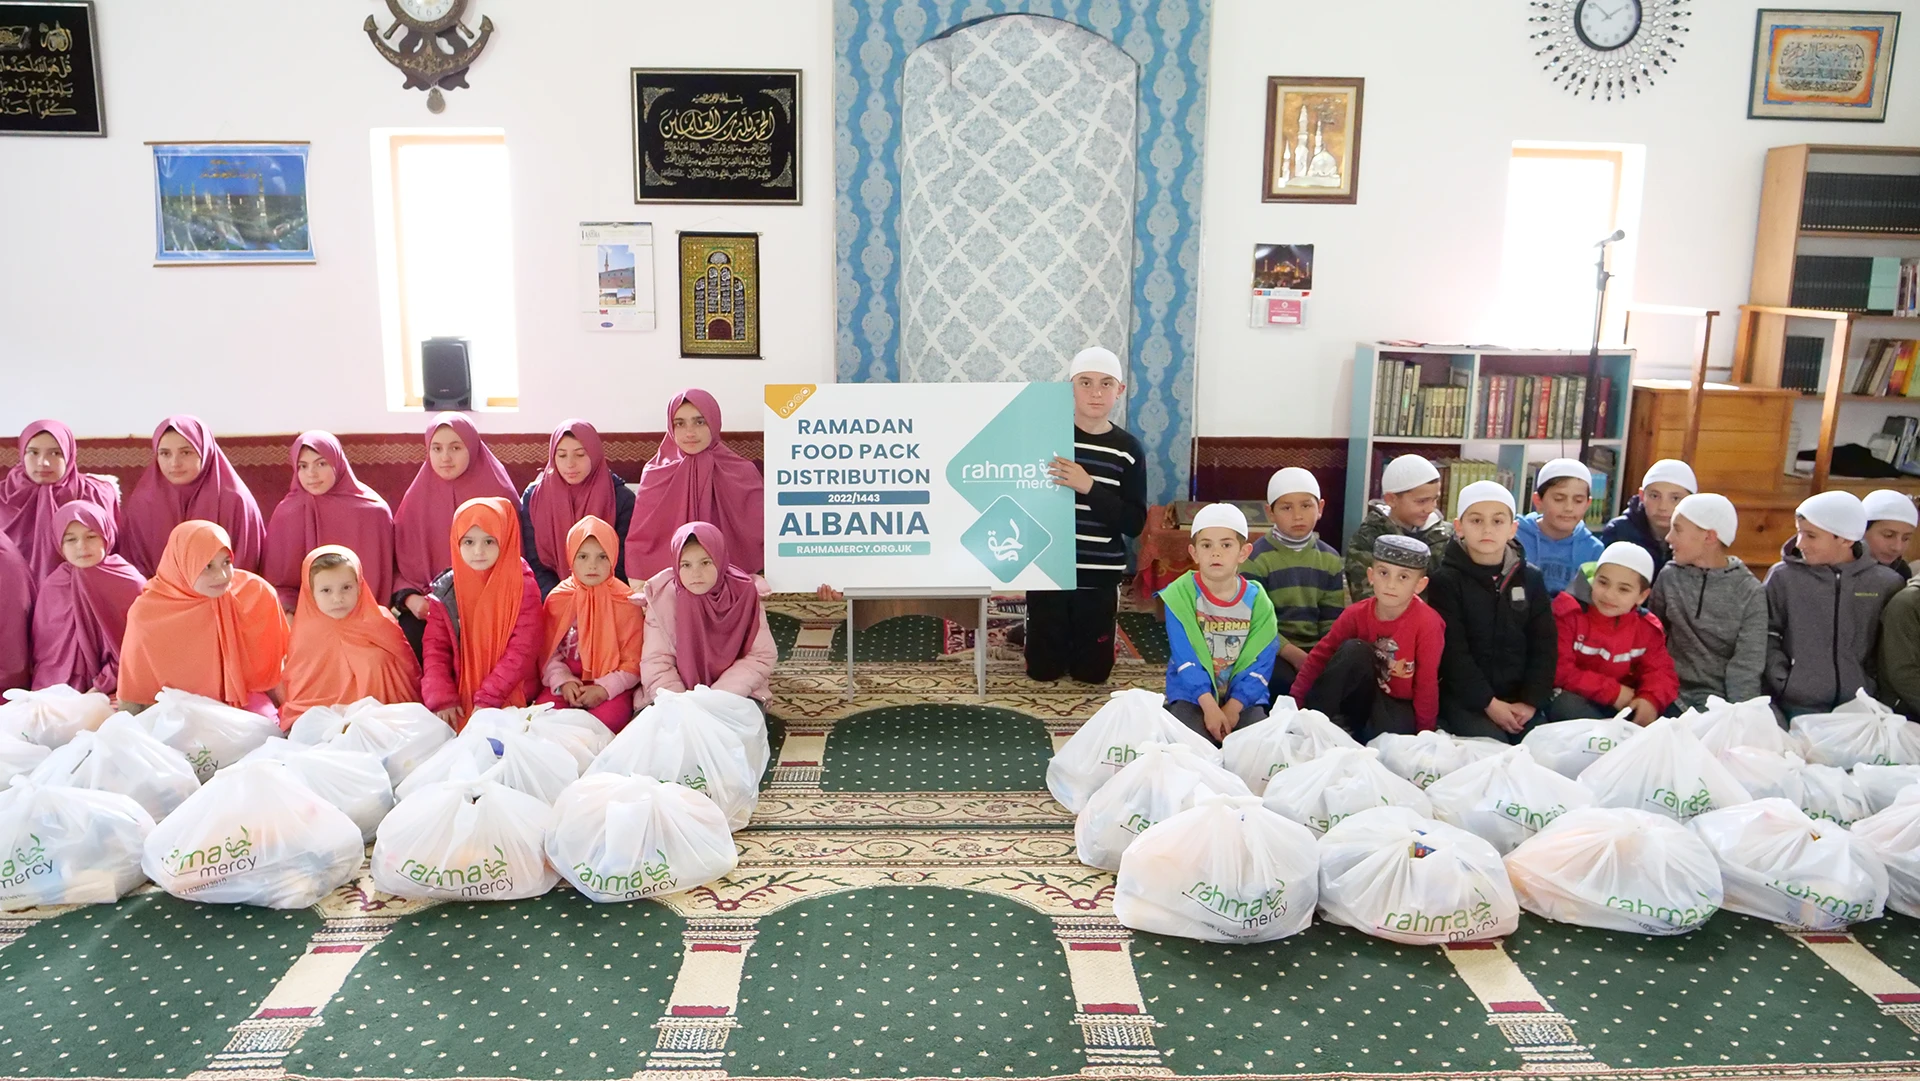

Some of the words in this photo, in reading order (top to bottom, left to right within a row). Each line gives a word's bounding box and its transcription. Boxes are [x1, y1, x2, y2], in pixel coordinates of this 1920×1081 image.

[416, 6, 421, 15] 7
[426, 8, 432, 16] 6
[797, 418, 913, 435] RAMADAN
[791, 444, 853, 460] FOOD
[860, 443, 920, 459] PACK
[777, 468, 930, 485] DISTRIBUTION
[962, 460, 1037, 479] rahma
[828, 493, 880, 504] 2022/1443
[779, 511, 930, 536] ALBANIA
[796, 543, 912, 554] RAHMAMERCY.ORG.UK
[1107, 744, 1145, 763] rah
[194, 760, 219, 774] rcy
[0, 860, 53, 889] mercy
[200, 856, 257, 878] mercy
[401, 859, 482, 887] rahma
[461, 877, 514, 897] mercy
[624, 878, 678, 899] mercy
[1189, 881, 1263, 918] rahma
[1242, 901, 1288, 930] mercy
[1384, 909, 1469, 932] rahma
